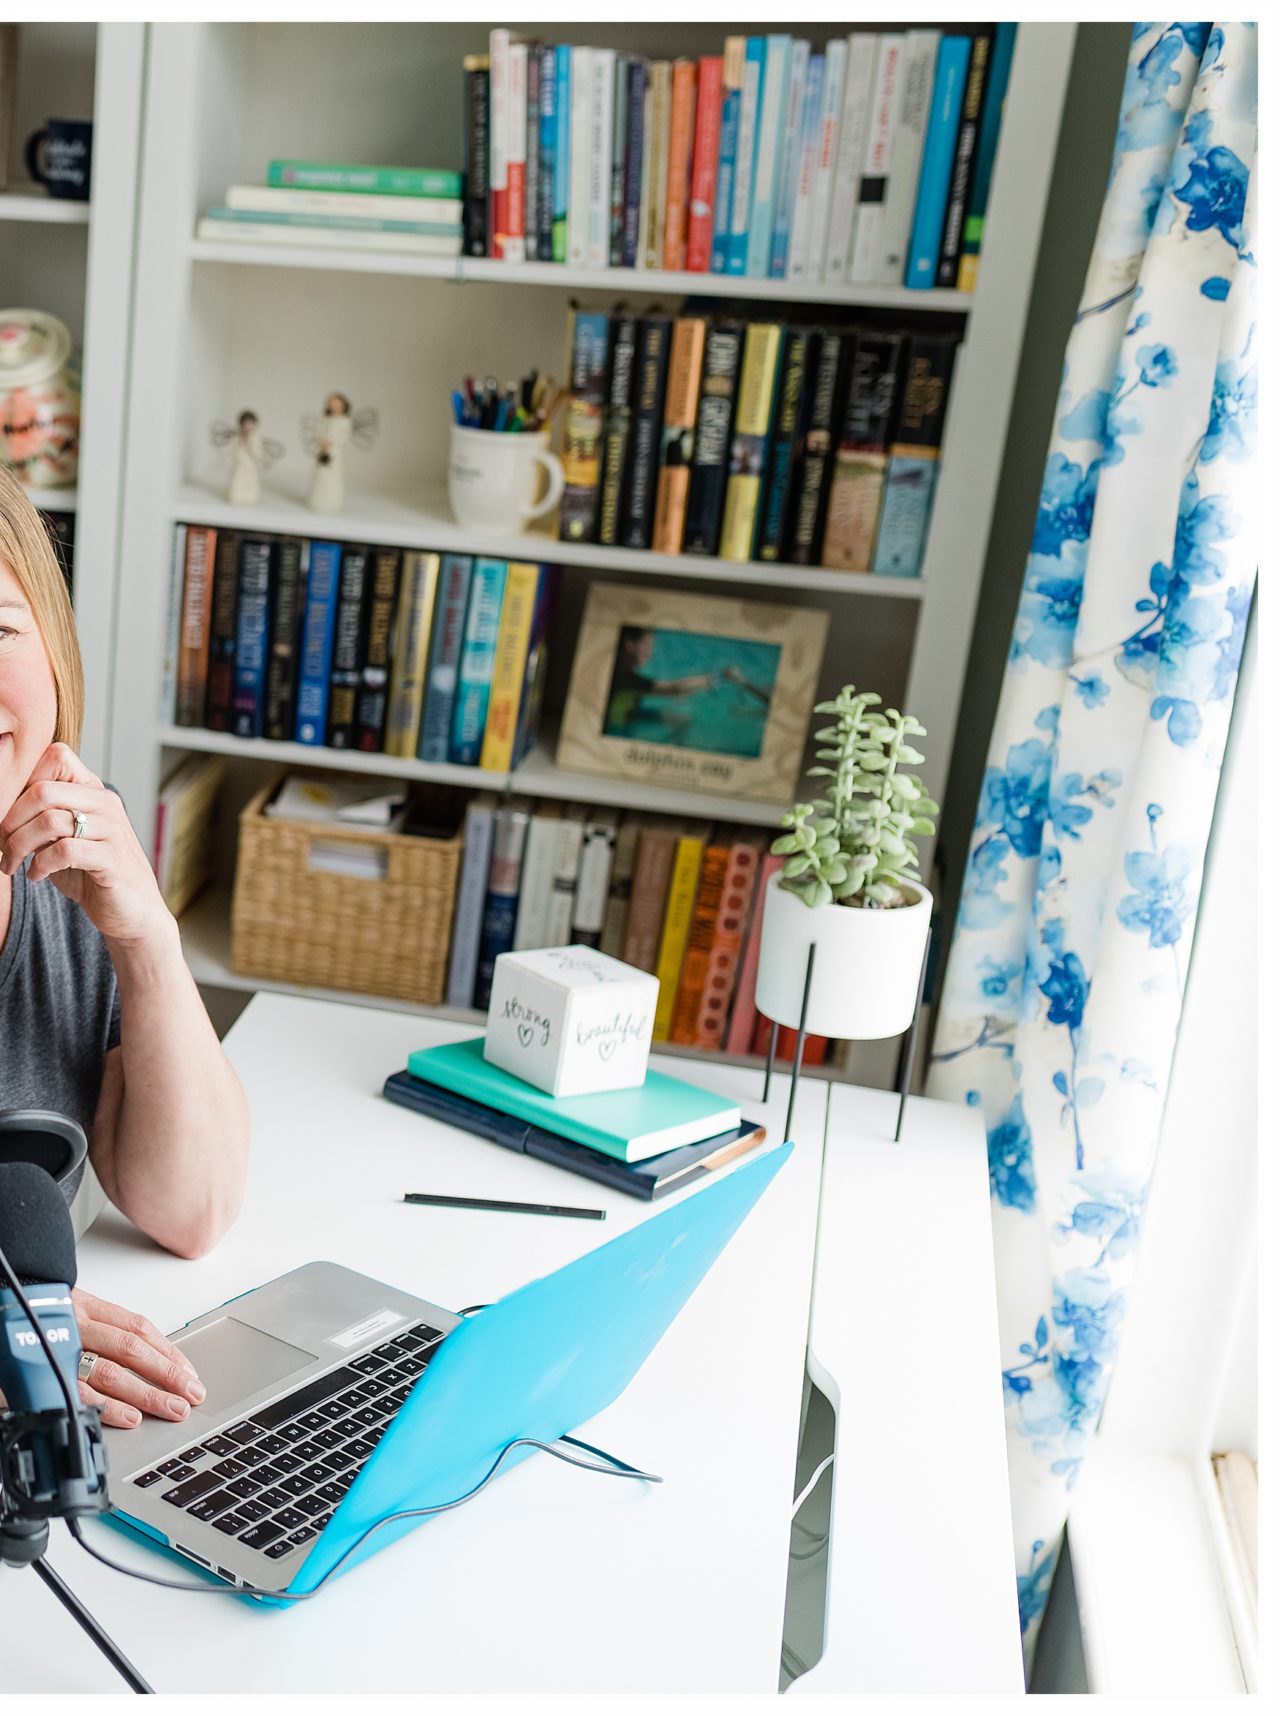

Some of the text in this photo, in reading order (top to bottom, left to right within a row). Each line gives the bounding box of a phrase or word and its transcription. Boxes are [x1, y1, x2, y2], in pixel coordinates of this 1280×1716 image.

[499, 998, 551, 1047] strong
[576, 1012, 647, 1046] beautiful
[15, 1327, 70, 1347] TOOR
